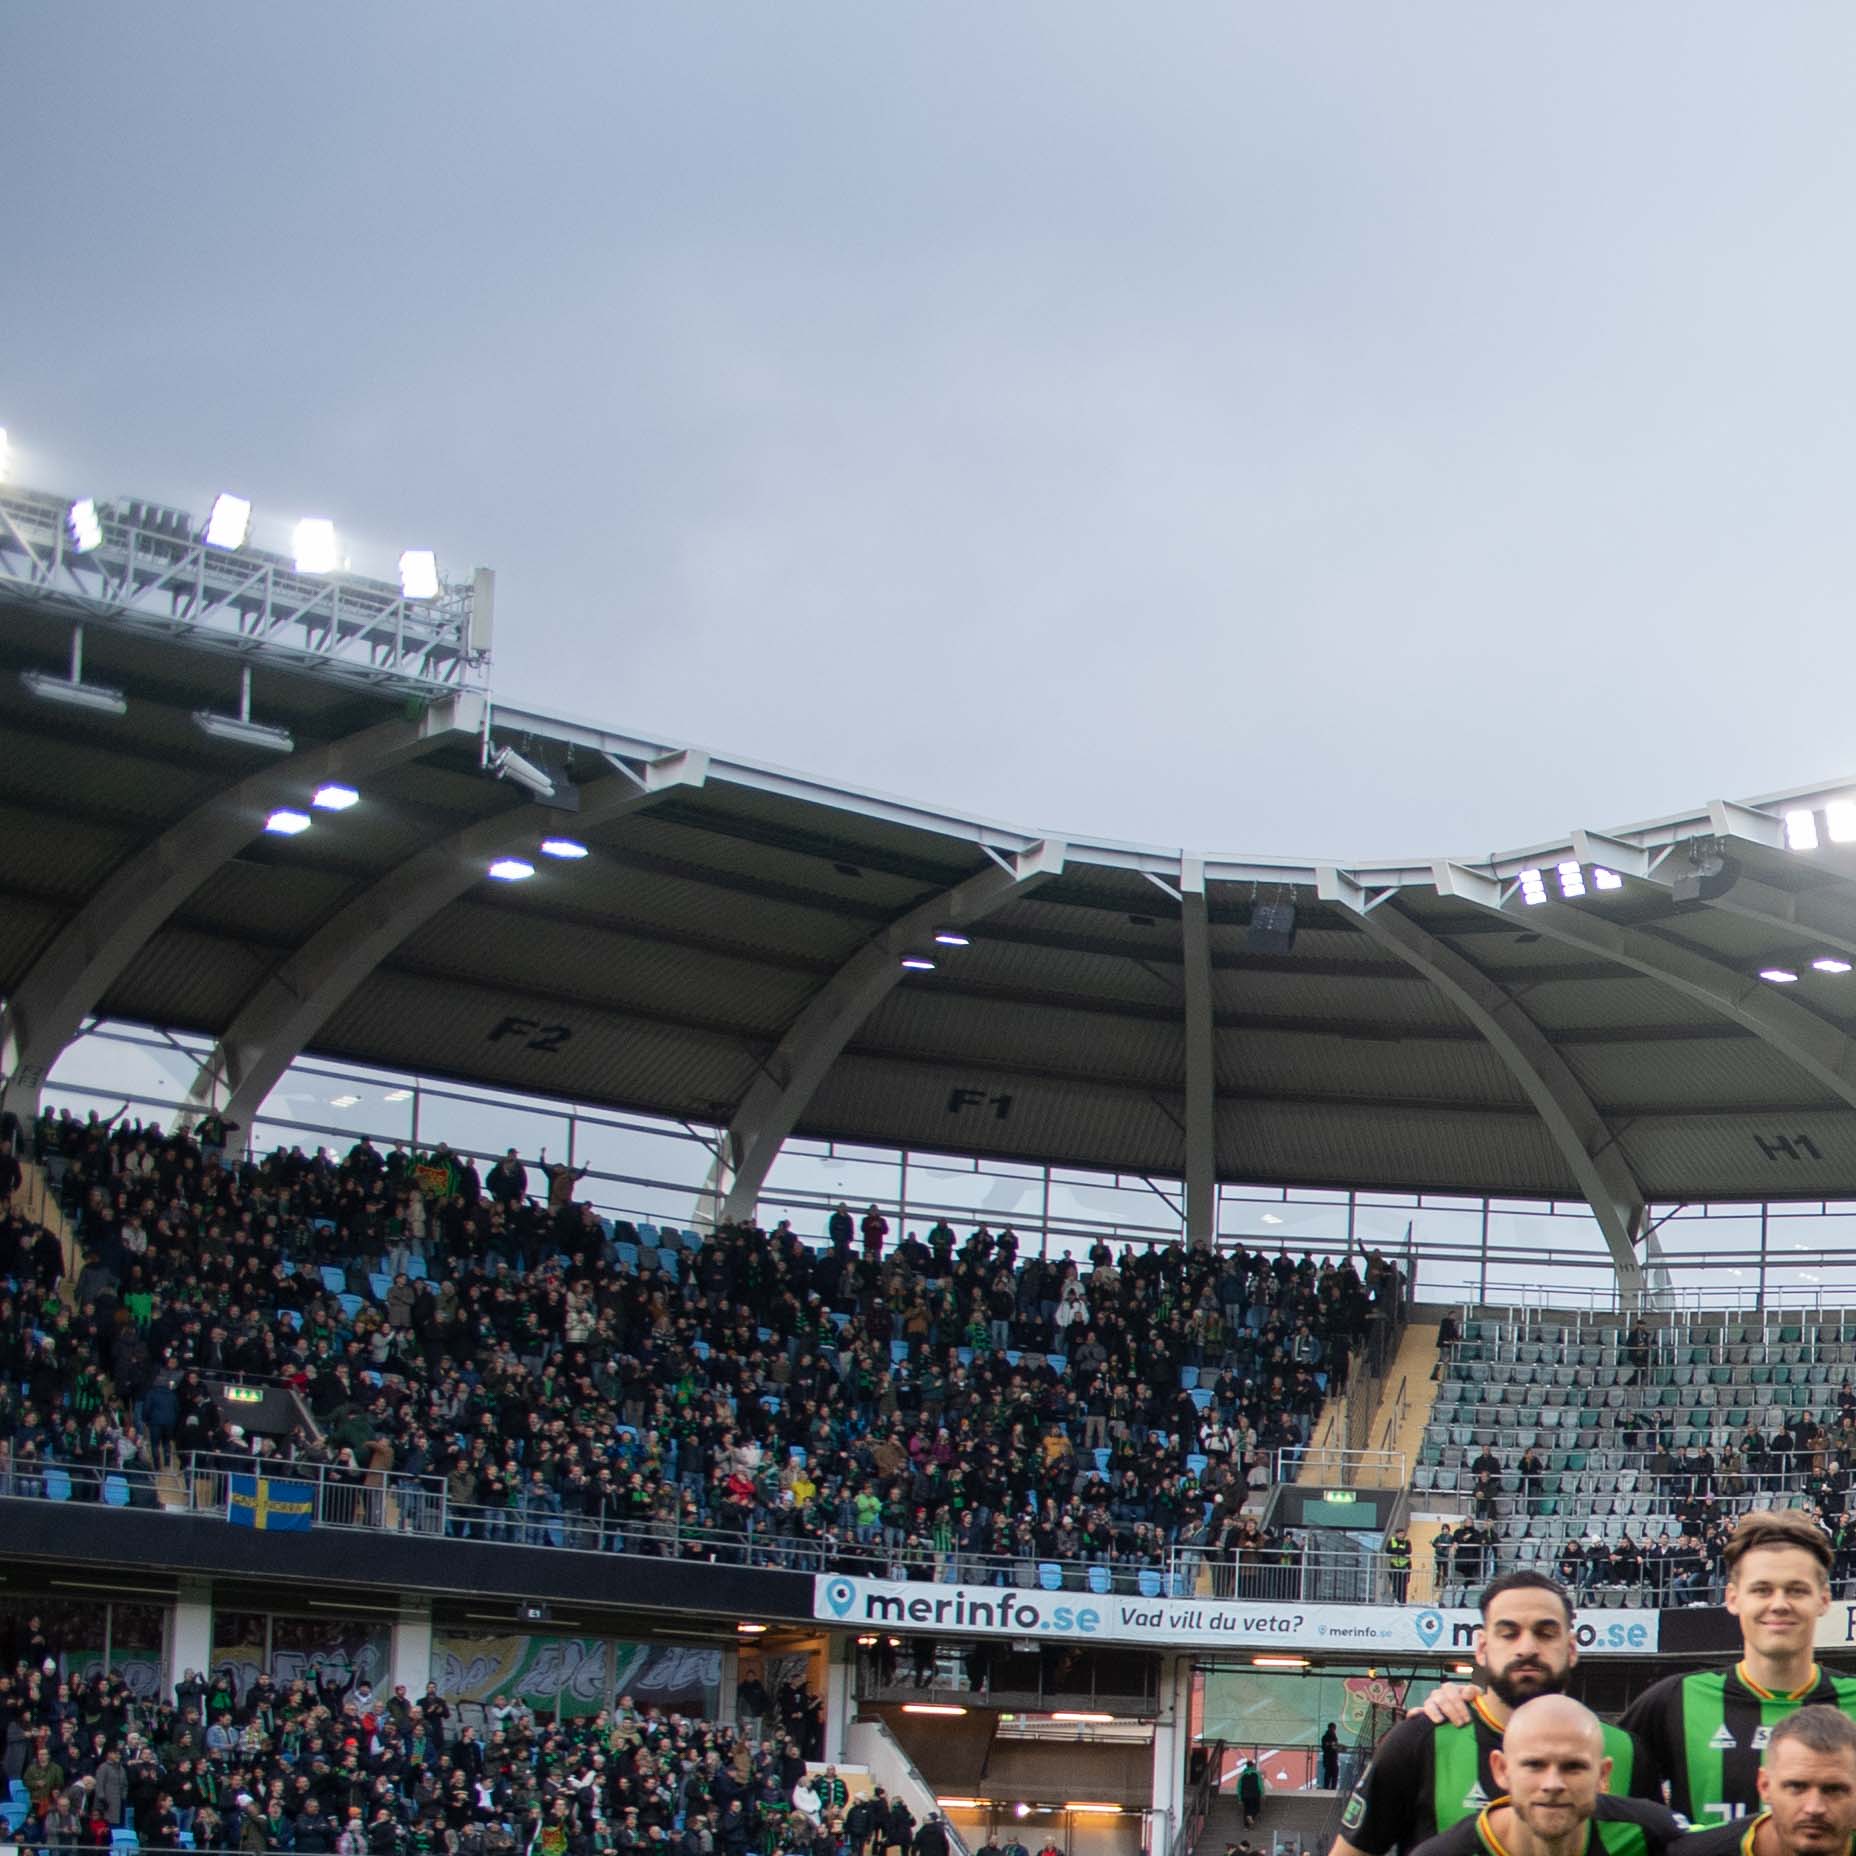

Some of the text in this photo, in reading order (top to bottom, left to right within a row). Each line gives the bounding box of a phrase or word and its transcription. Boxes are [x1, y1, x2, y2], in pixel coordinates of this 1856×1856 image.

[487, 1015, 574, 1054] F2
[947, 1088, 1013, 1121] F1
[1753, 1133, 1823, 1162] H1
[865, 1591, 1101, 1635] merinfo.se
[1120, 1606, 1305, 1633] Vad vill du veta?
[1329, 1626, 1393, 1638] merinfo.se
